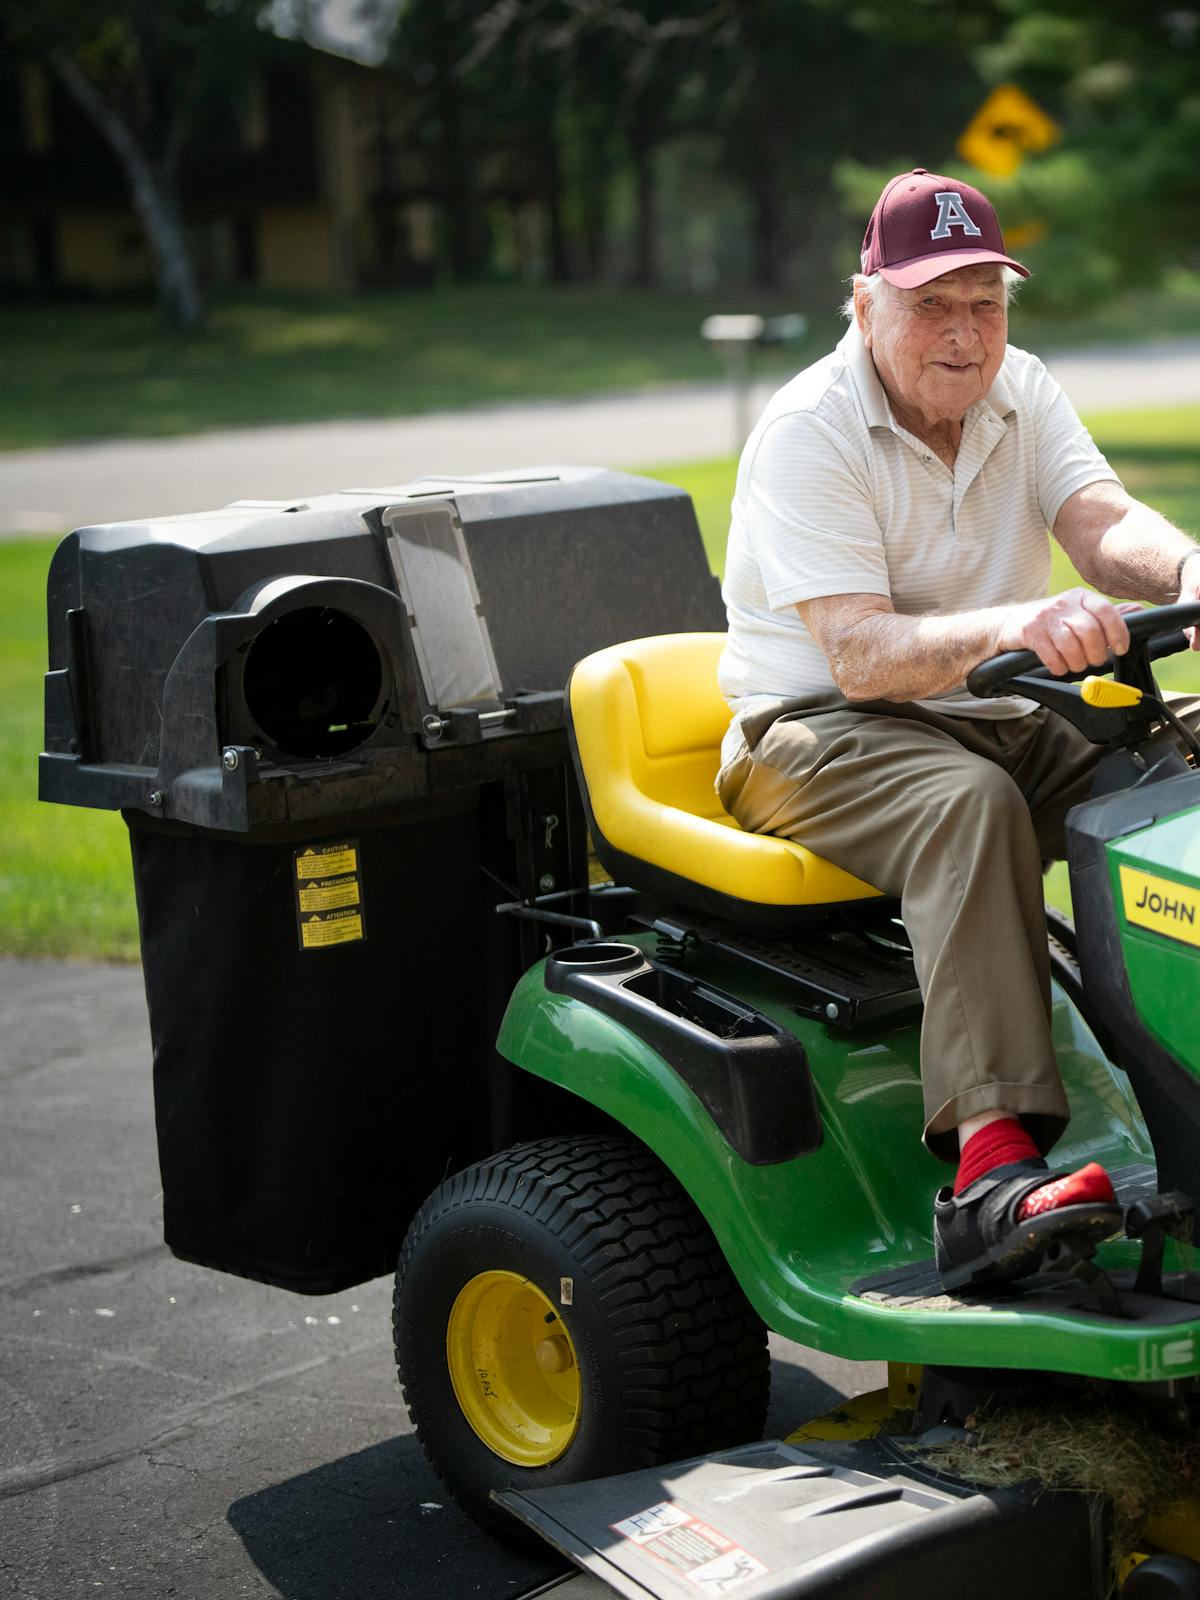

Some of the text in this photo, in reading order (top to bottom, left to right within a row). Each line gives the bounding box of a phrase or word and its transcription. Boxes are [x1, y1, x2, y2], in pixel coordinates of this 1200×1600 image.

[930, 192, 982, 240] A
[322, 844, 348, 854] CAUTION
[326, 909, 357, 920] ATTENTION
[1136, 886, 1195, 925] JOHN
